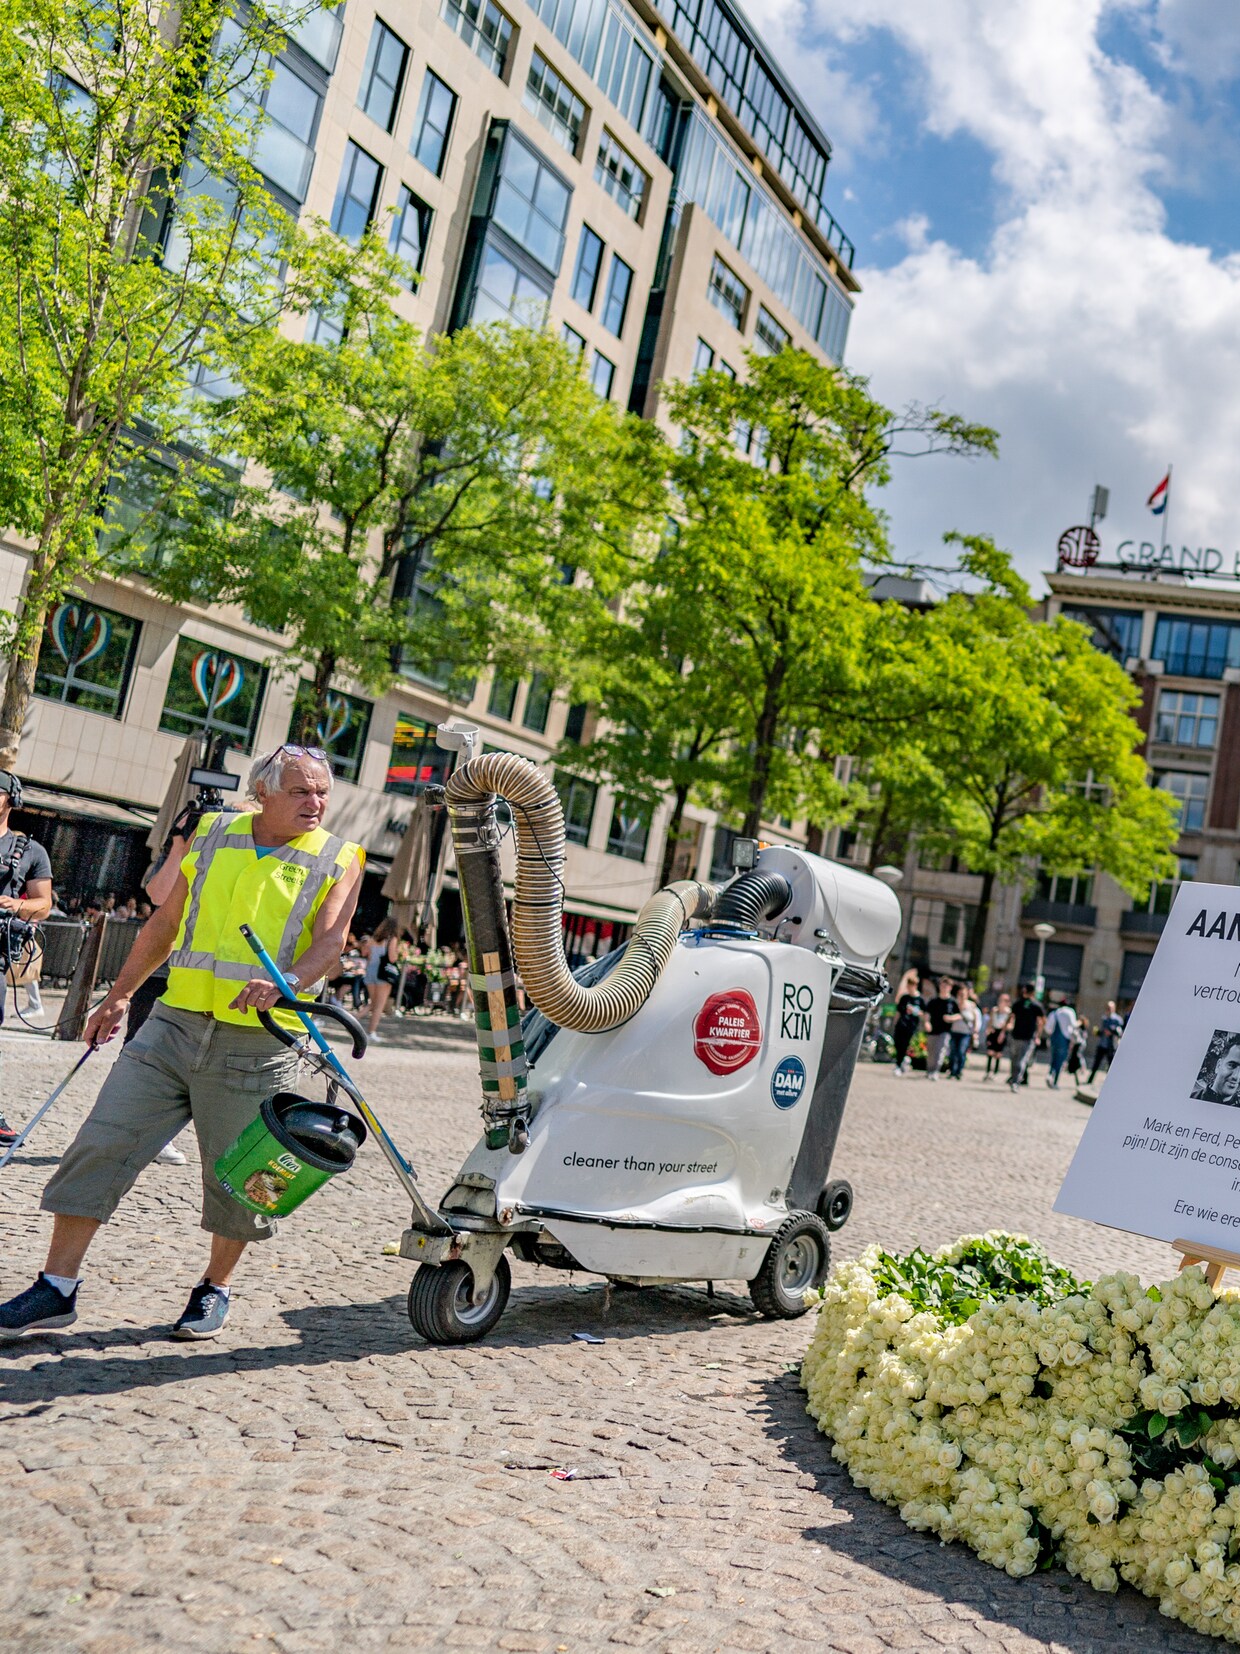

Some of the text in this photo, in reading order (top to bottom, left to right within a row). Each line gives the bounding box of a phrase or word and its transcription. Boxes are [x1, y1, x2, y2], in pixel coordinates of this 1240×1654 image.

[1117, 540, 1223, 573] GRAND
[275, 871, 304, 886] Streets
[280, 863, 304, 875] Green
[782, 982, 813, 1012] RO
[709, 1026, 750, 1039] KWARTIER
[718, 1016, 745, 1028] PALEIS
[780, 1011, 812, 1041] KIN
[775, 1072, 803, 1090] DAM
[1143, 1117, 1172, 1135] Mark
[1175, 1125, 1190, 1138] en
[1191, 1127, 1221, 1147] Ferd,
[1123, 1134, 1149, 1150] pijn!
[1149, 1138, 1167, 1154] Dit
[1167, 1144, 1189, 1160] zijn
[1191, 1148, 1206, 1163] de
[563, 1151, 718, 1175] cleaner than your street
[1173, 1199, 1194, 1216] Ere
[1197, 1207, 1219, 1222] wie
[1220, 1212, 1240, 1228] ere
